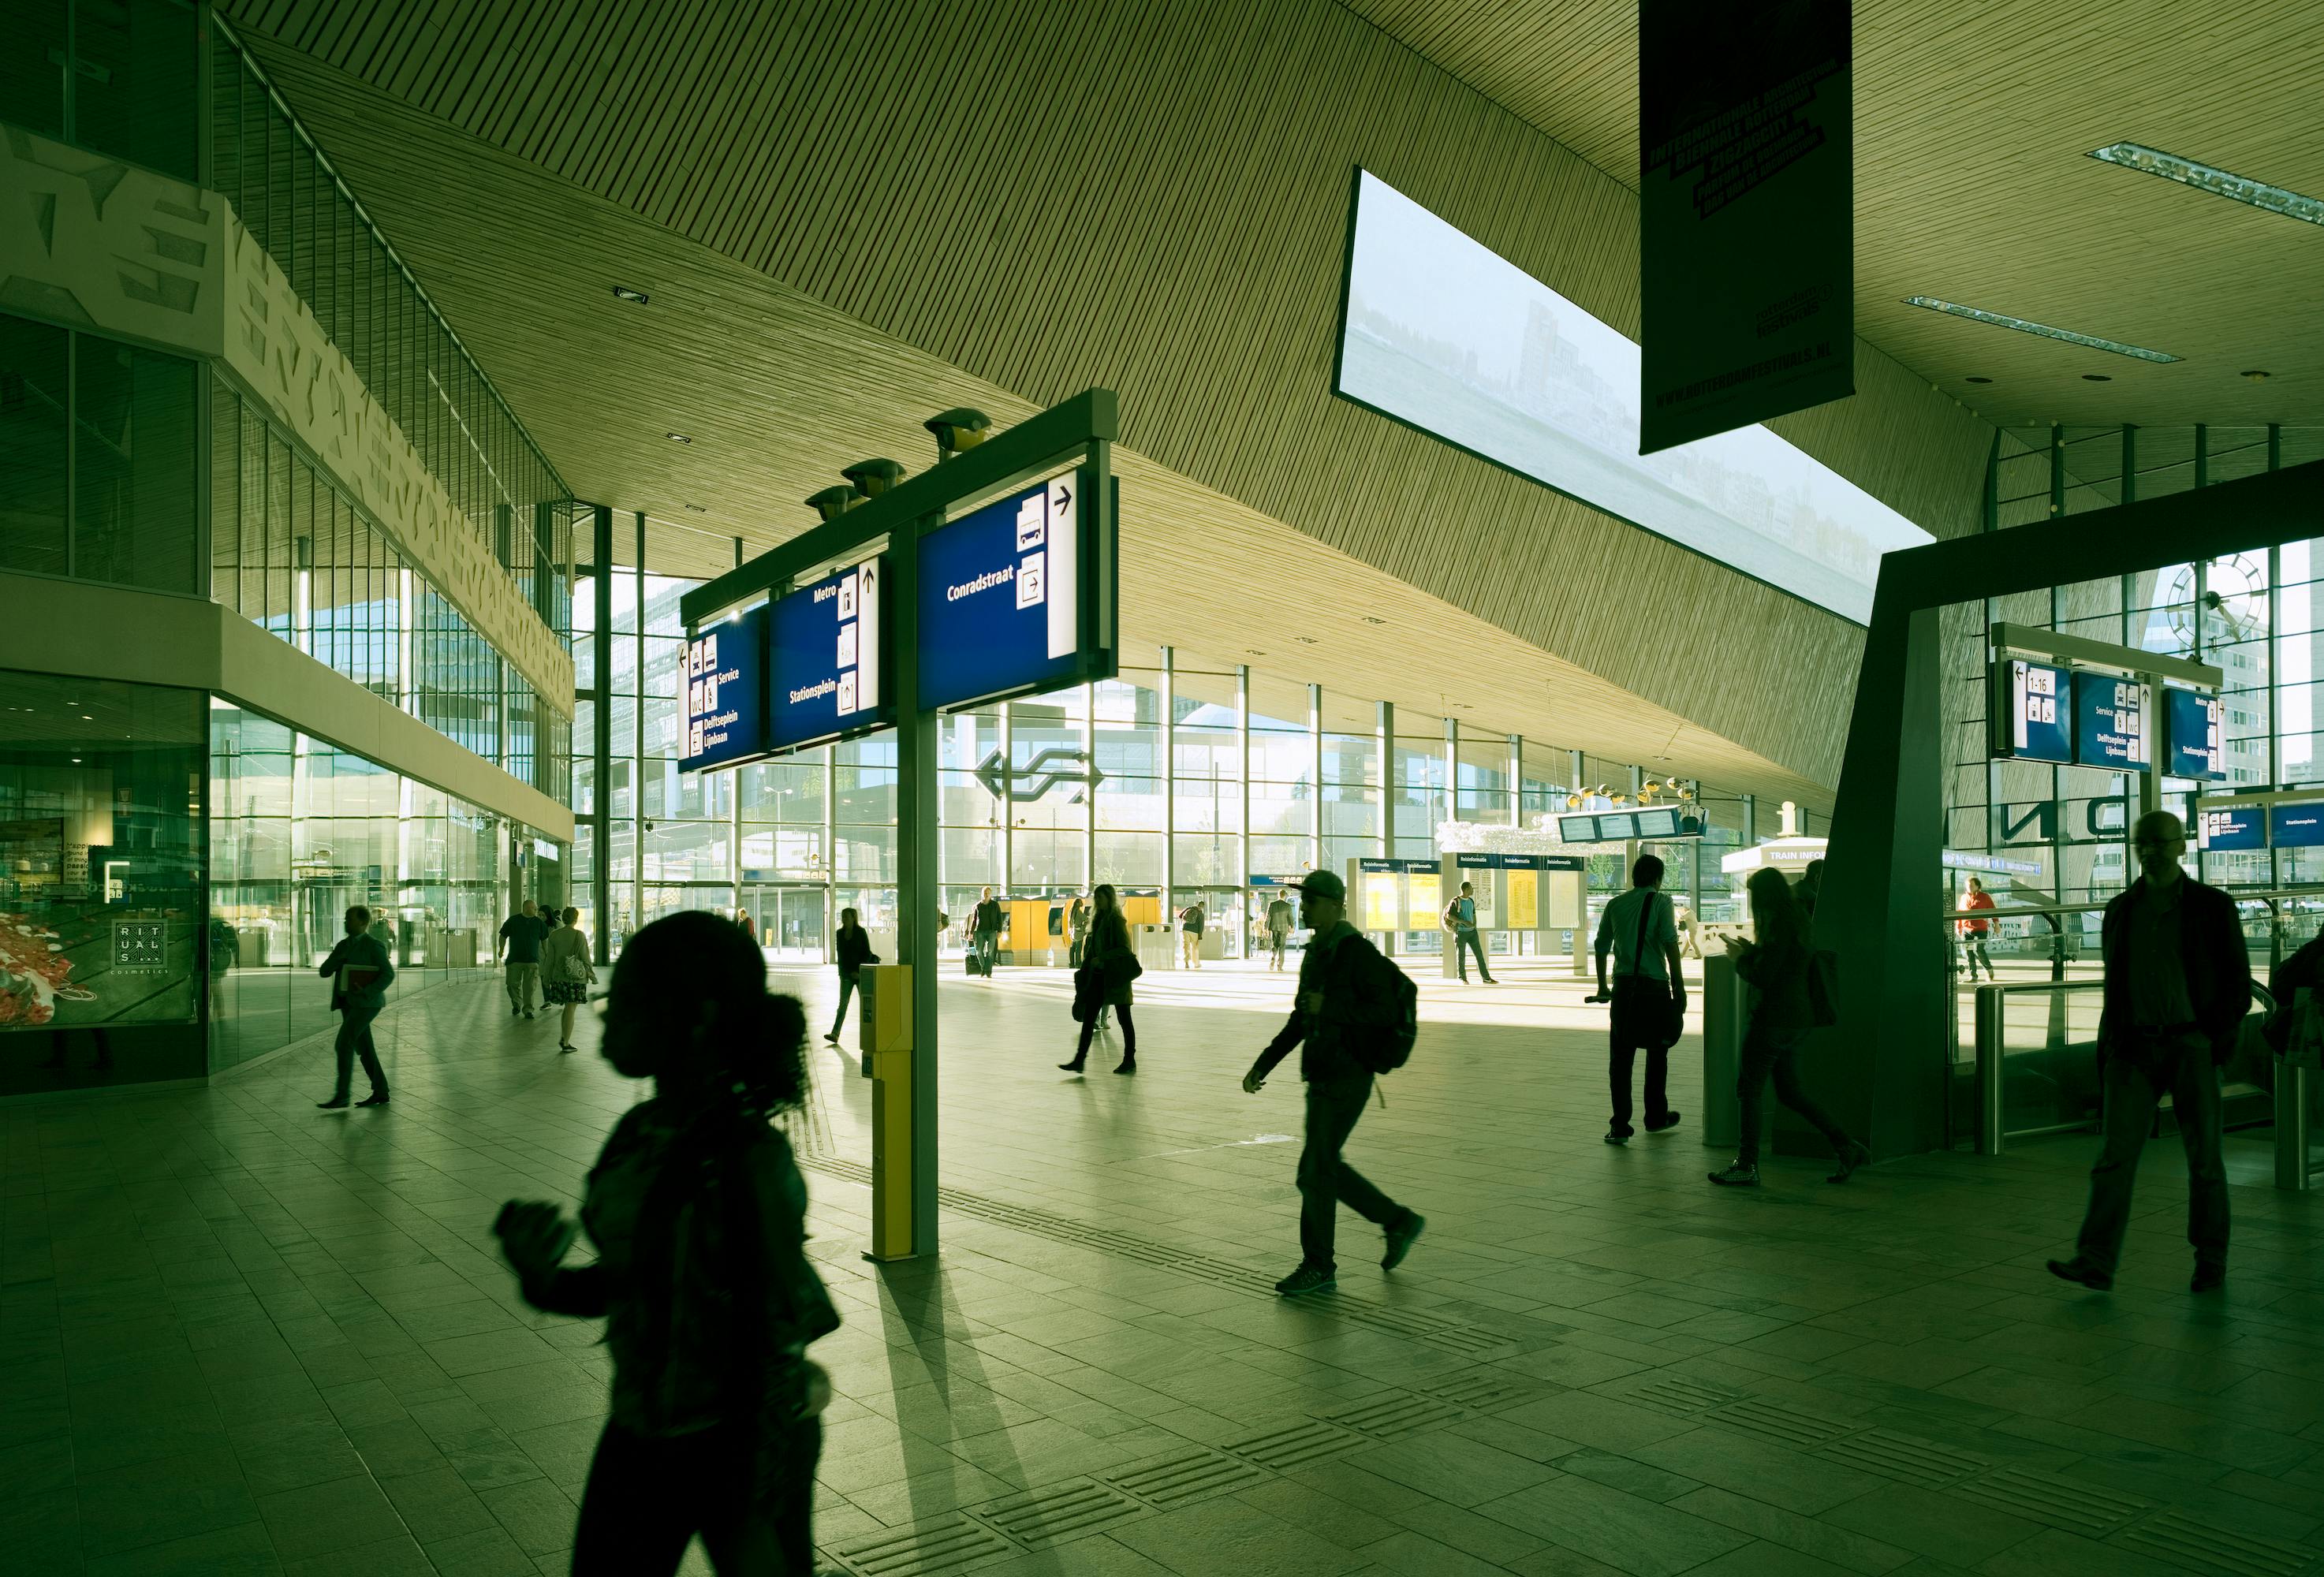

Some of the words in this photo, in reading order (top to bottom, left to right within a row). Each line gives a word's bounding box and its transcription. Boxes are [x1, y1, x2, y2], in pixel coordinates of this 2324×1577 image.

[1744, 85, 1811, 132] ROTTERDAM
[946, 564, 1014, 602] Conradstraat
[814, 584, 837, 604] Metro
[718, 668, 740, 685] Service
[789, 678, 836, 705] Stationsplein
[691, 699, 703, 714] WC
[2095, 706, 2113, 717] Service
[703, 709, 738, 730] Delftseplein
[2128, 724, 2138, 733] WC
[703, 731, 728, 749] Lijnbaan
[2097, 733, 2127, 746] Delftseplein
[2106, 746, 2127, 757] Lijnbaan
[1770, 852, 1797, 860] TRAIN
